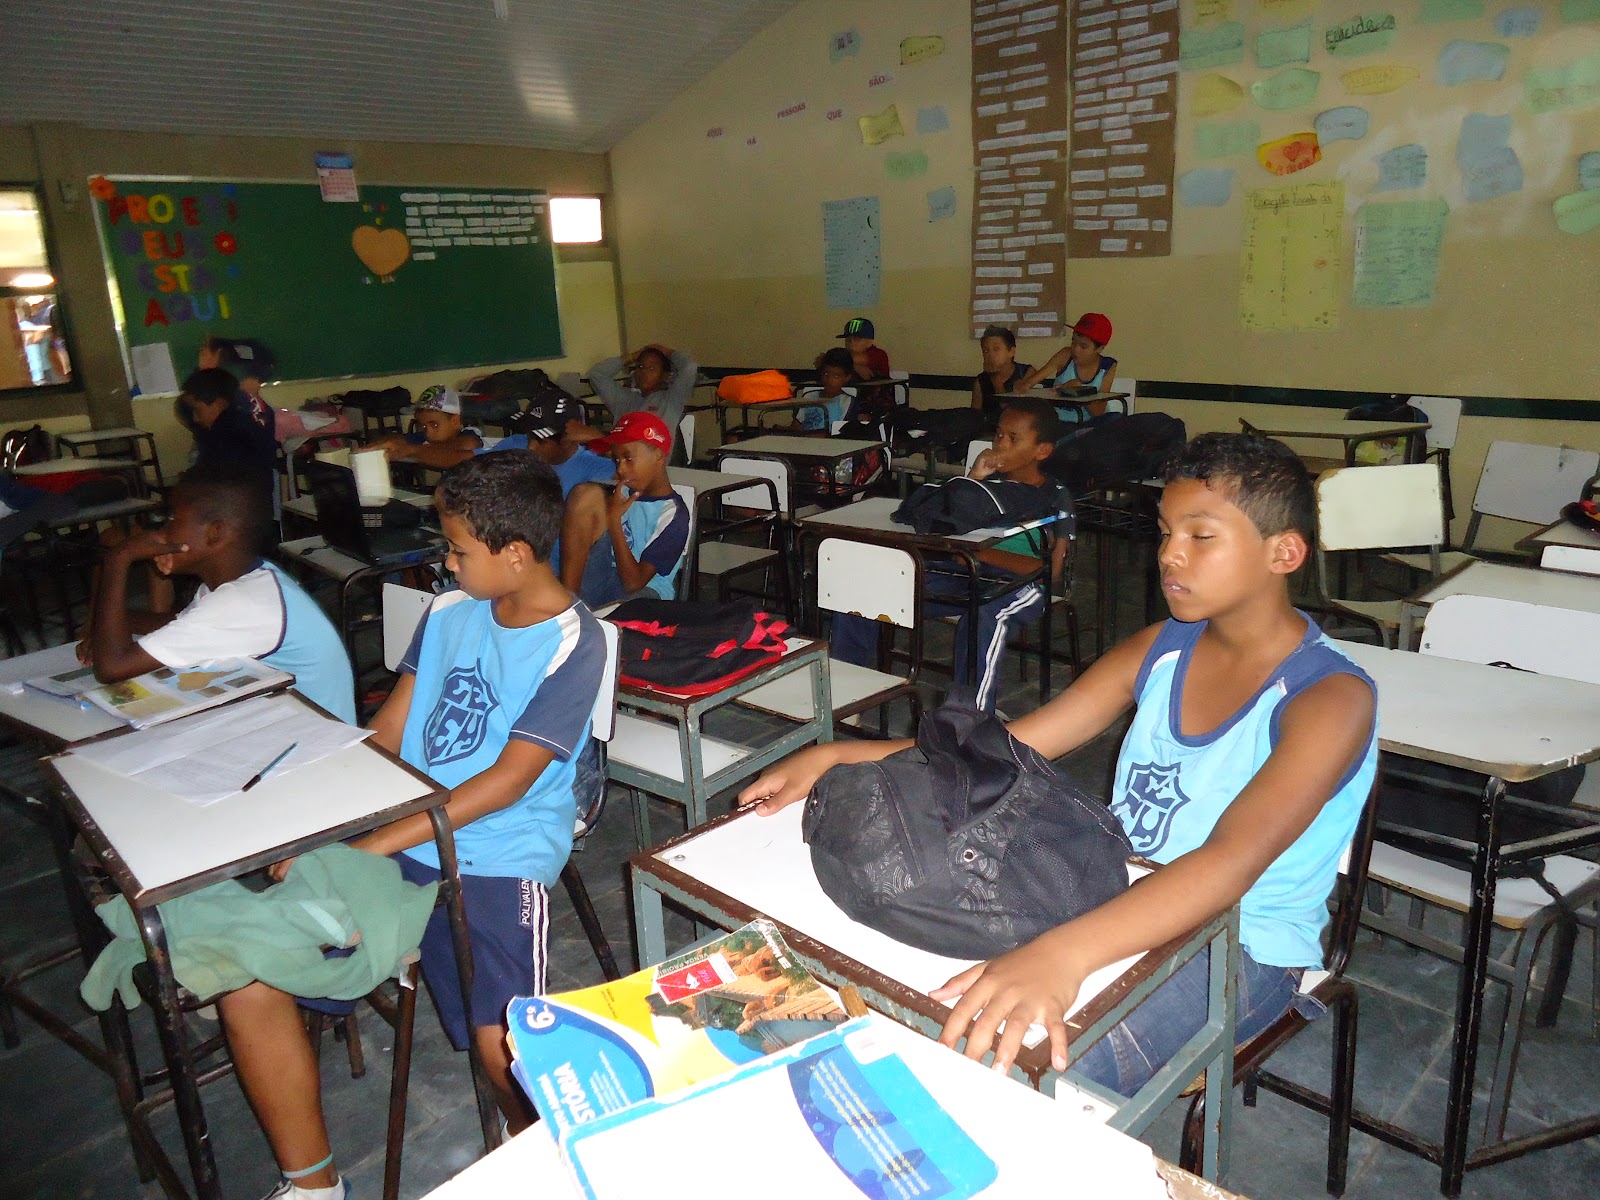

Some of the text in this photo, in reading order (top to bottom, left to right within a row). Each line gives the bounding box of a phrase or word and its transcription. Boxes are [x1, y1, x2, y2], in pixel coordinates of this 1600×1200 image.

[777, 102, 806, 118] PESSOAS
[826, 108, 843, 121] QUE
[144, 293, 231, 328] AQUI
